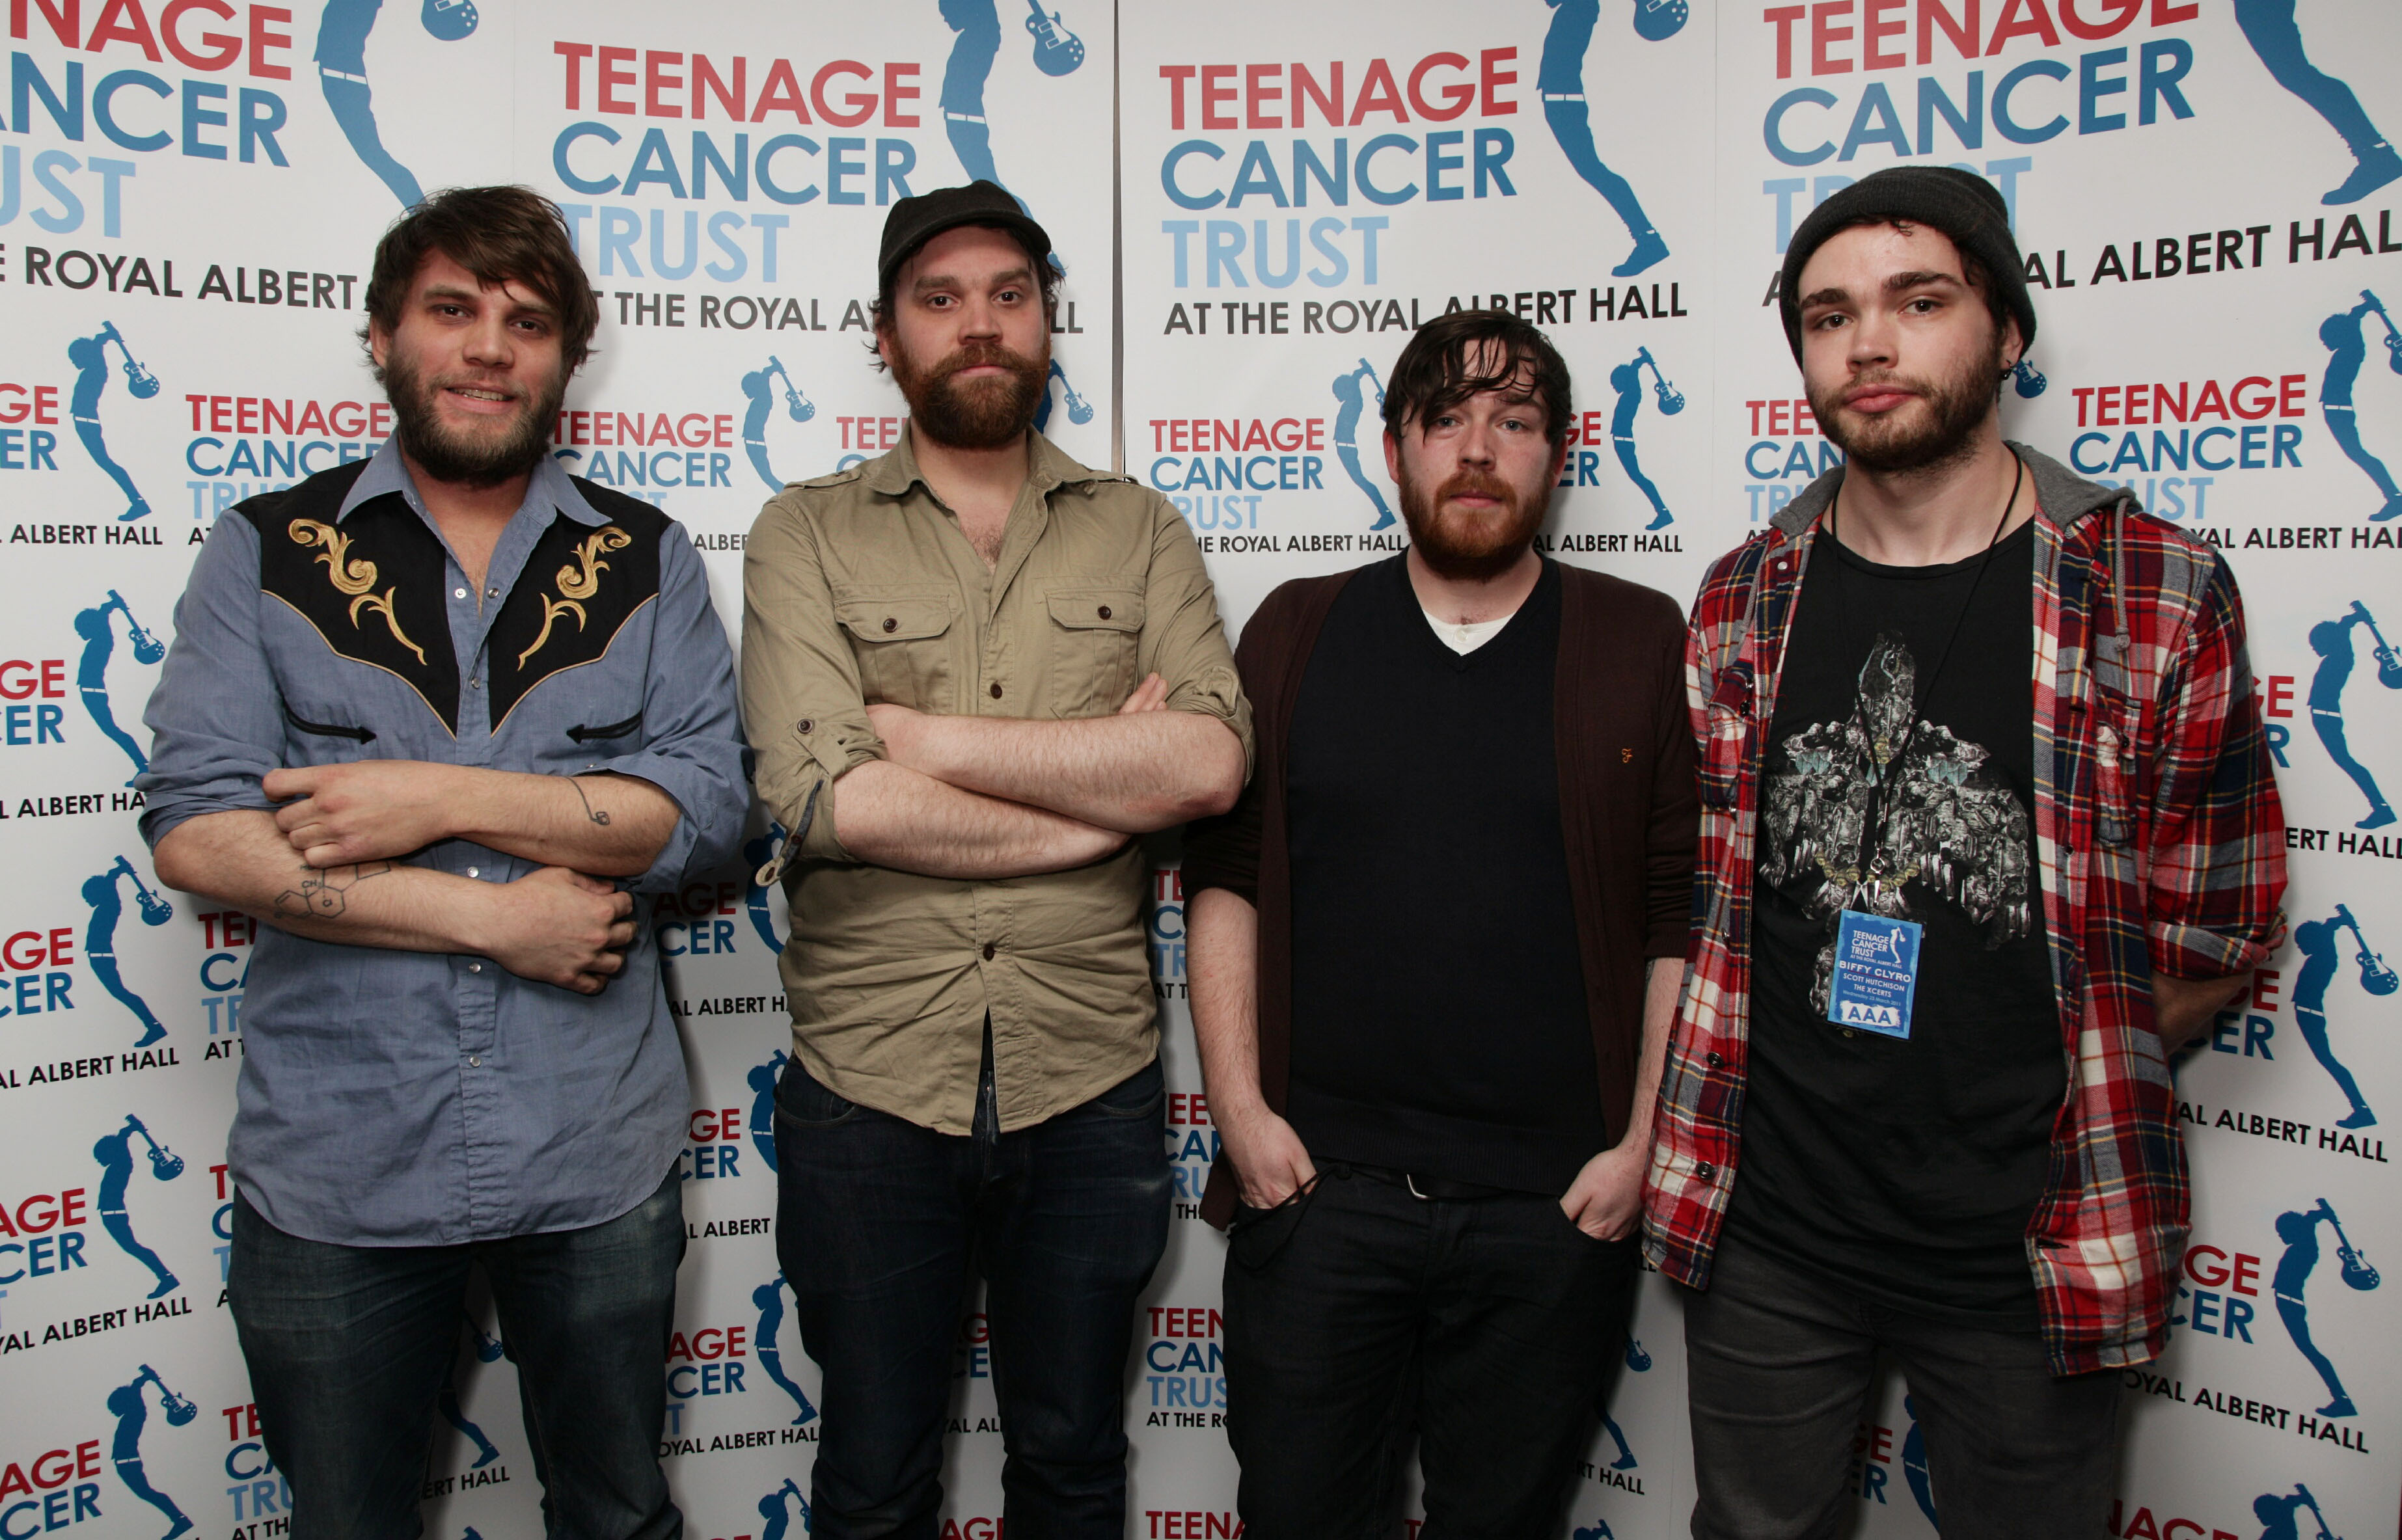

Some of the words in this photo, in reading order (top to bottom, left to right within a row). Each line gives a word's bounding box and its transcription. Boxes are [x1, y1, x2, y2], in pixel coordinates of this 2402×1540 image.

[10, 0, 292, 81] NAGE
[554, 41, 921, 128] TEENAGE
[1160, 46, 1517, 129] TEENAGE
[0, 51, 290, 167] NCER
[1763, 38, 2195, 167] CANCER
[553, 121, 915, 206] CANCER
[1161, 128, 1518, 210] CANCER
[554, 202, 789, 284] TRUST
[1162, 215, 1389, 288] TRUST
[2090, 225, 2271, 287] ALBERT
[2289, 209, 2402, 263] HAL
[25, 246, 183, 298] ROYAL
[198, 264, 357, 310] ALBERT
[614, 291, 685, 327] THE
[700, 295, 826, 331] ROYAL
[1049, 301, 1083, 334] LL
[1164, 302, 1212, 335] AT
[1221, 301, 1289, 334] THE
[1303, 298, 1422, 334] ROYAL
[1590, 282, 1688, 321] HALL
[185, 394, 390, 438] TEENAGE
[2072, 374, 2306, 427] TEENAGE
[553, 411, 733, 448] TEENAGE
[1149, 418, 1324, 452] TEENAGE
[1745, 440, 1848, 480] CAN
[2069, 424, 2302, 475] CANCER
[1150, 455, 1324, 492] CANCER
[1169, 495, 1262, 530] RUST
[10, 525, 97, 545] ALBERT
[105, 526, 163, 545] HALL
[694, 534, 748, 550] ALBE
[1221, 535, 1281, 552] ROYAL
[1287, 535, 1353, 552] ALBERT
[1359, 535, 1404, 552] HALL
[1561, 535, 1628, 552] ALBERT
[1634, 535, 1683, 552] HALL
[2190, 528, 2235, 549] YAL
[2244, 527, 2342, 548] ALBERT
[2351, 526, 2402, 548] HA
[17, 794, 104, 818] ALBERT
[113, 791, 145, 811] HA
[2285, 827, 2329, 851] ERT
[655, 920, 737, 956] CER
[1851, 938, 1888, 952] CANCER
[1851, 946, 1874, 958] TRUST
[1853, 930, 1889, 944] TEENAGE
[1839, 960, 1872, 974] BIFFY
[1874, 968, 1911, 982] CLYRO
[1843, 973, 1864, 982] SCOTT
[1865, 978, 1905, 992] HUTCHISON
[698, 997, 766, 1015] ALBERT
[1866, 986, 1892, 997] XCERTS
[1848, 1006, 1891, 1024] AAA
[28, 1055, 115, 1085] ALBERT
[122, 1047, 180, 1072] HALL
[204, 1039, 232, 1060] AT
[2215, 1108, 2311, 1145] ALBERT
[2318, 1128, 2388, 1163] HALL
[703, 1218, 771, 1237] ALBERT
[1176, 1204, 1203, 1219] TH
[0, 1232, 88, 1284] CER
[42, 1308, 128, 1345] ALBERT
[134, 1297, 193, 1325] HALL
[1147, 1307, 1224, 1338] TEEN
[1147, 1341, 1224, 1373] CAN
[666, 1362, 746, 1399] CER
[1147, 1376, 1227, 1408] TRUS
[1147, 1412, 1169, 1426] AT
[1174, 1412, 1206, 1427] THE
[2124, 1368, 2186, 1403] OYAL
[2193, 1388, 2290, 1430] ALBERT
[2298, 1414, 2369, 1454] HALL
[659, 1438, 704, 1458] OYAL
[709, 1430, 776, 1452] ALBERT
[781, 1427, 819, 1444] HAL
[461, 1466, 511, 1491] HALL
[1600, 1467, 1645, 1495] HALL
[0, 1483, 102, 1540] CER
[263, 1517, 290, 1537] TH
[1145, 1511, 1246, 1539] TEEN
